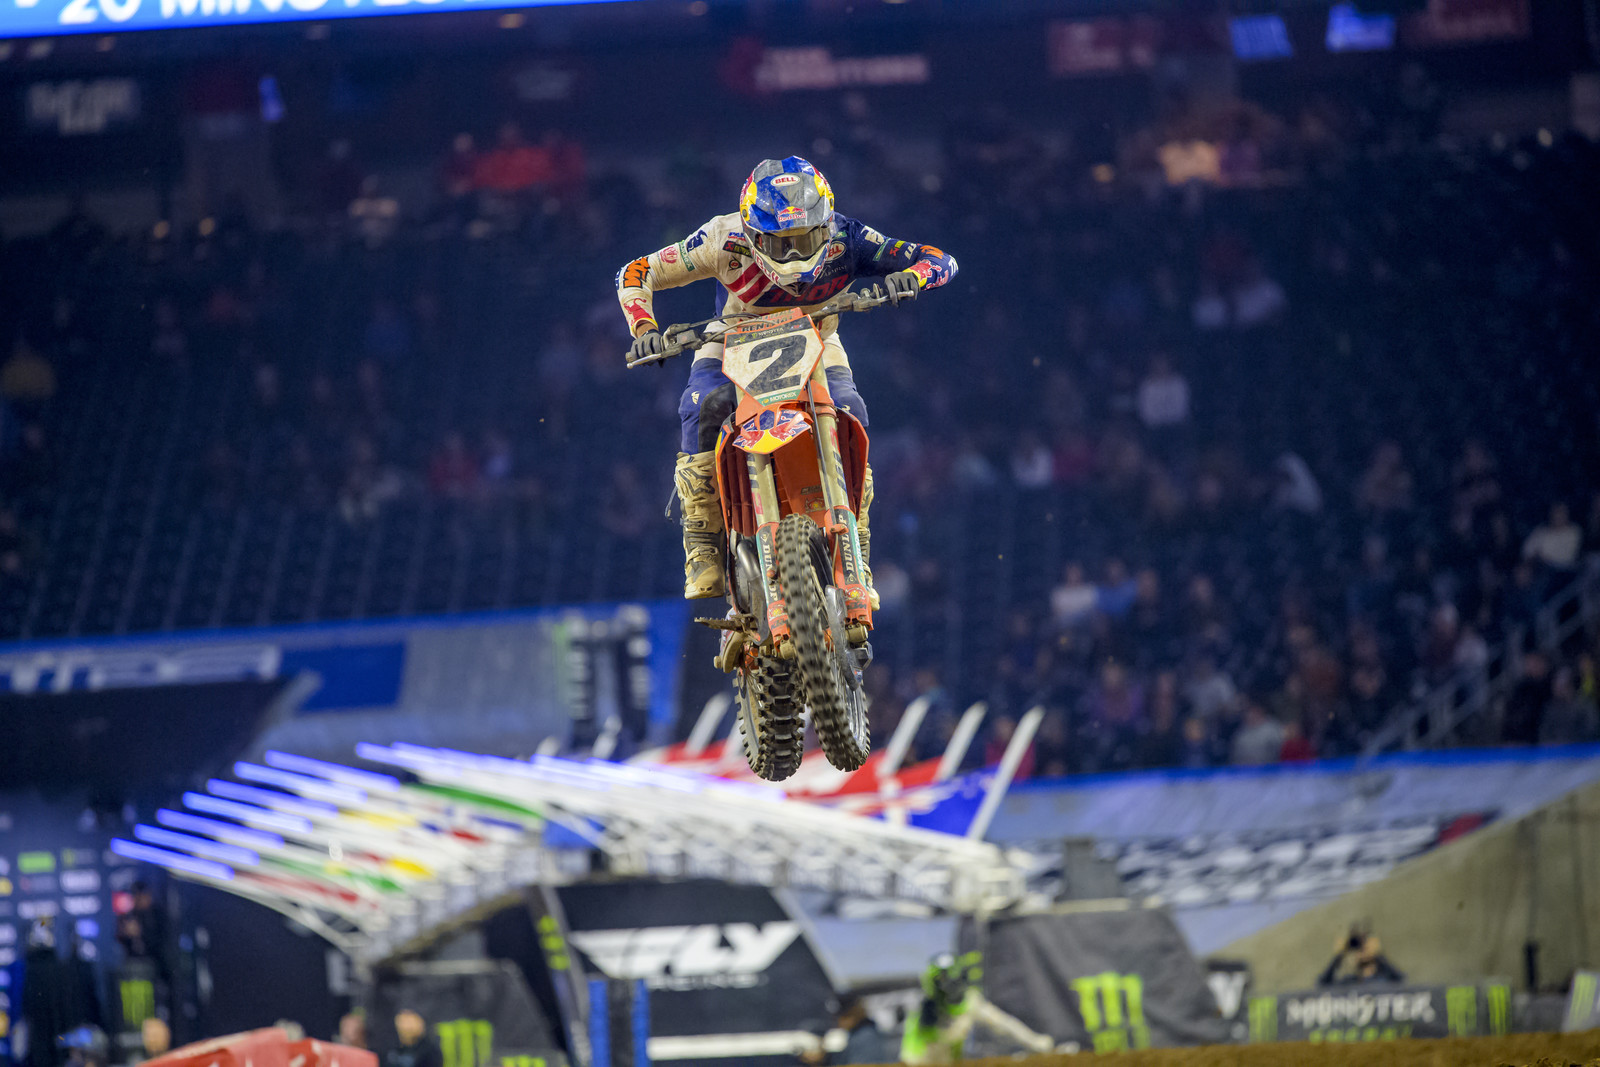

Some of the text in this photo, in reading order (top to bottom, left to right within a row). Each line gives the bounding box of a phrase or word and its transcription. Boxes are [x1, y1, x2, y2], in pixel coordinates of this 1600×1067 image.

[778, 212, 806, 222] Red Bull
[769, 274, 849, 303] THOR
[744, 334, 808, 397] 2
[769, 391, 797, 402] MOTOREX
[838, 514, 855, 573] DUNLP
